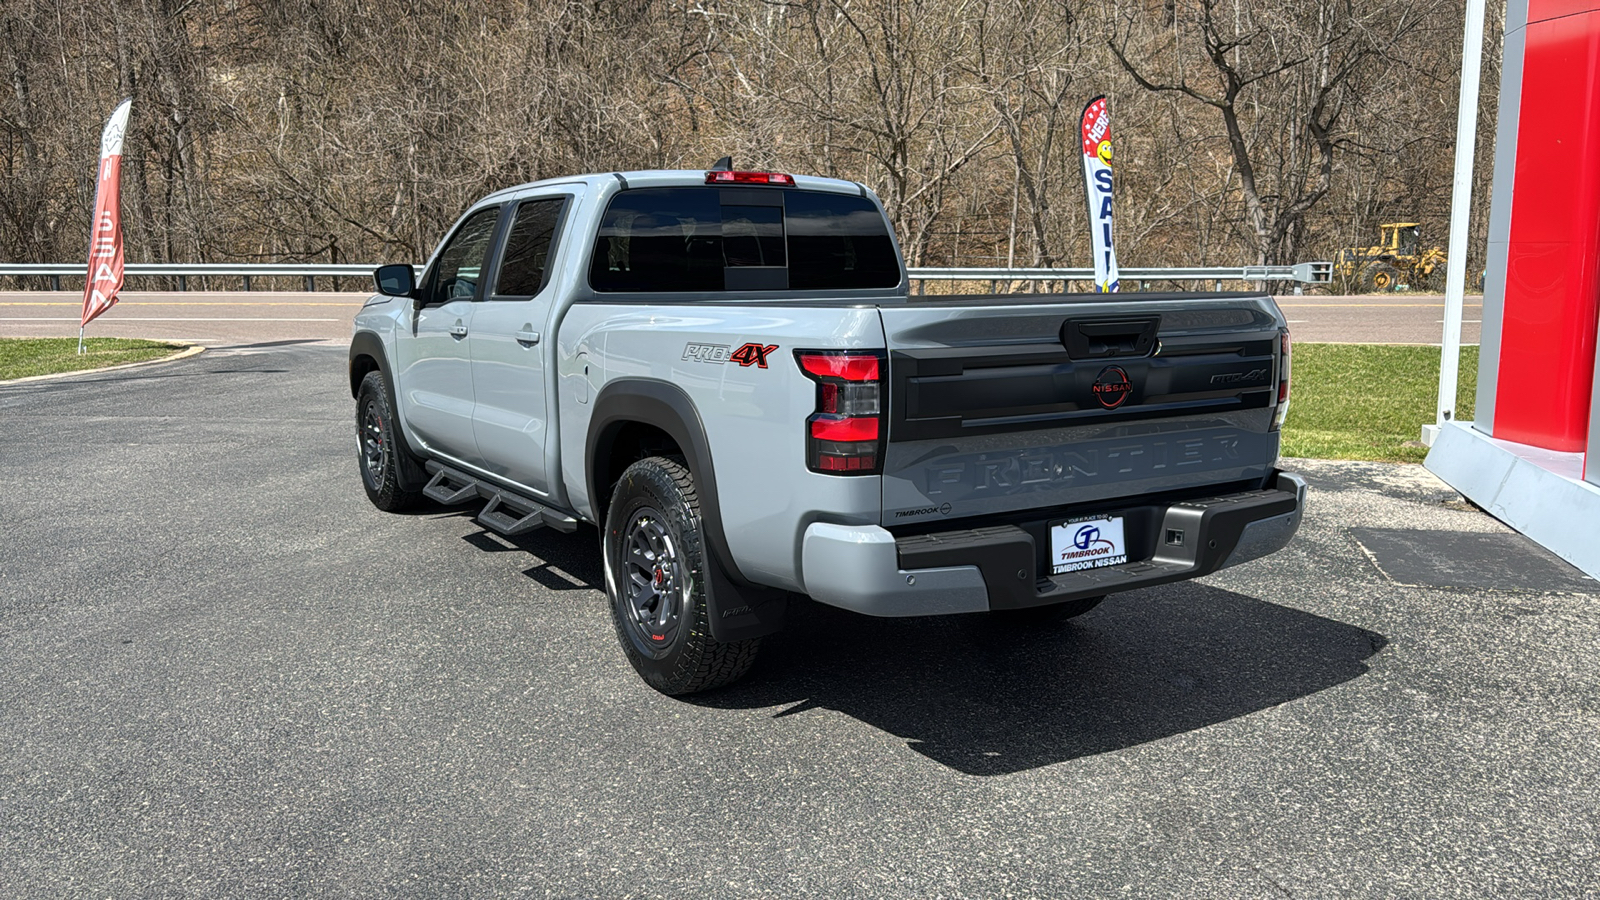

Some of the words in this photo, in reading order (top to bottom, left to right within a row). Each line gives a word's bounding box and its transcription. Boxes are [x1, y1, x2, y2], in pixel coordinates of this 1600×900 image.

[1092, 383, 1132, 393] NISSAN
[895, 506, 940, 518] TIMBROOK
[1061, 546, 1110, 560] TIMBROOK
[1053, 560, 1094, 574] TIMBROOK
[1095, 555, 1127, 567] NISSAN
